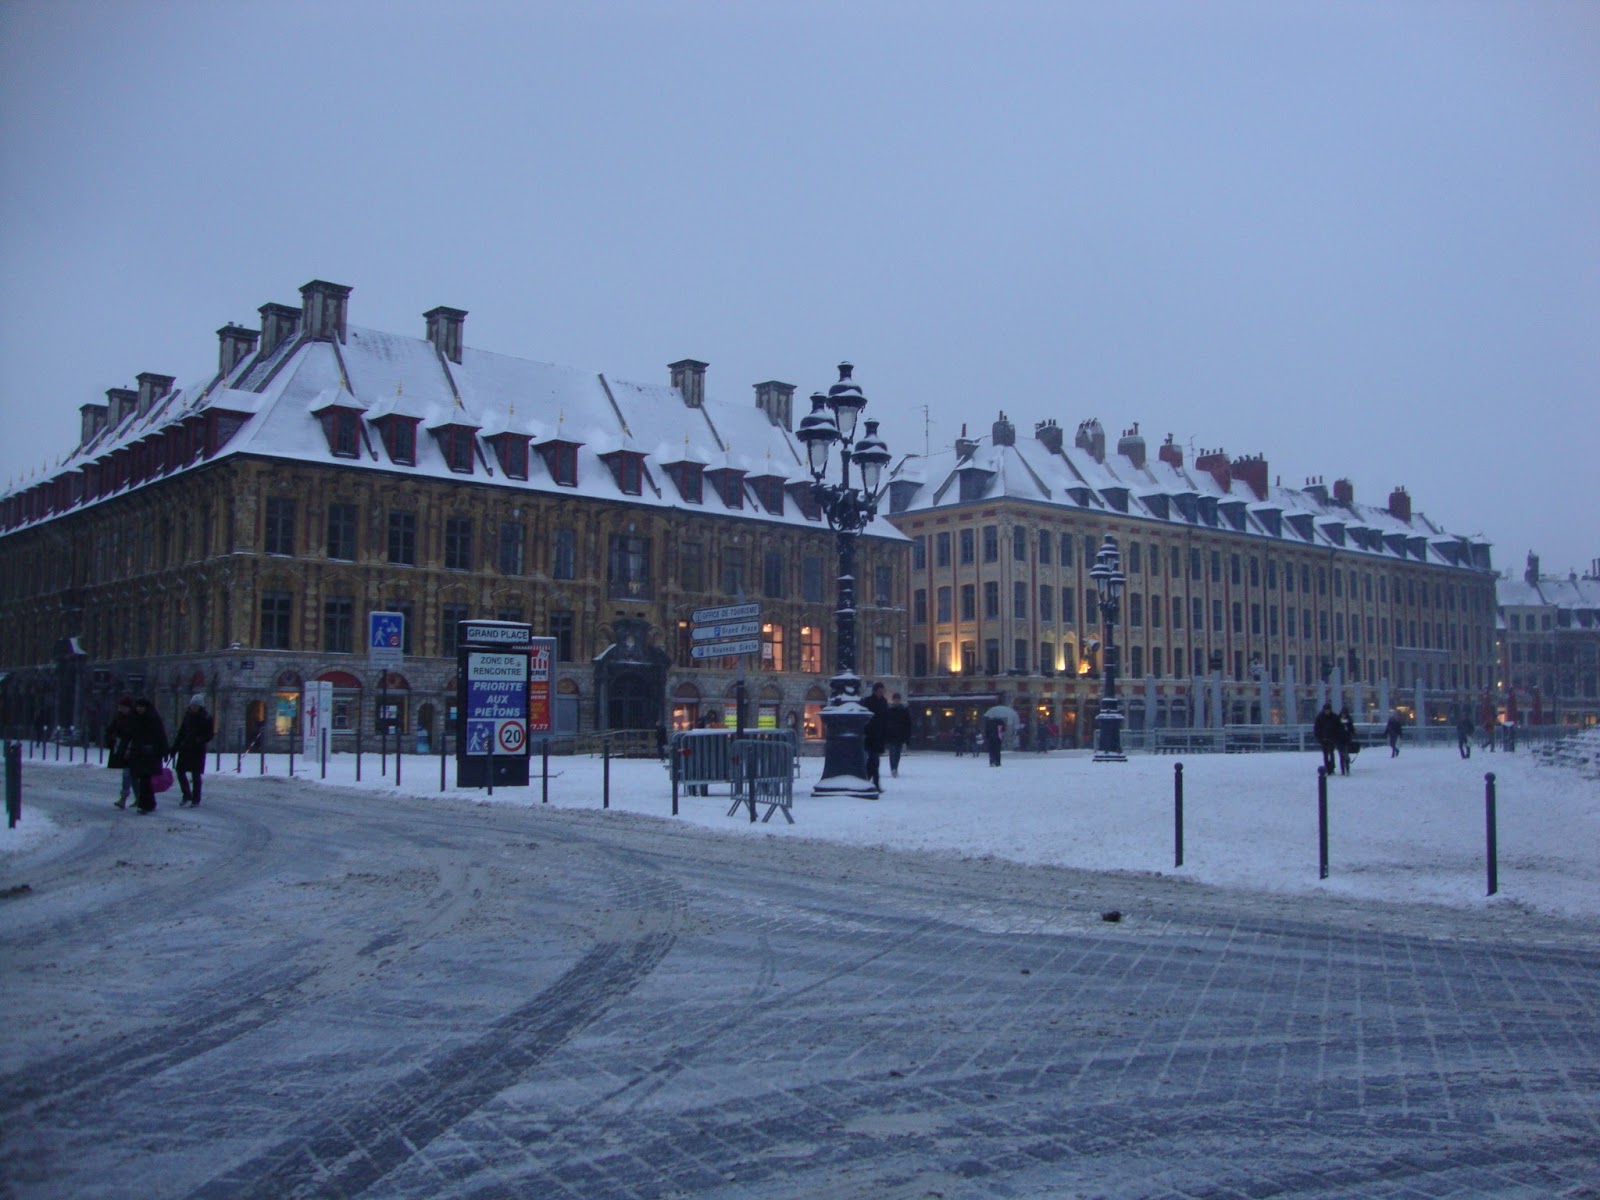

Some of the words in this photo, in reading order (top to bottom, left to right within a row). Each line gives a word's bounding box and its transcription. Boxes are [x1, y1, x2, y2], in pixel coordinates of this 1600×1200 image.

[703, 611, 719, 620] OFFICE
[721, 609, 728, 617] DE
[730, 606, 757, 616] TOURISME
[468, 629, 499, 639] GRAND
[500, 630, 528, 640] PLACE
[473, 667, 522, 676] RENCONTRE
[474, 682, 522, 692] PRIORITE
[486, 695, 508, 704] AUX
[475, 707, 520, 717] PIETONS
[504, 729, 521, 744] 20
